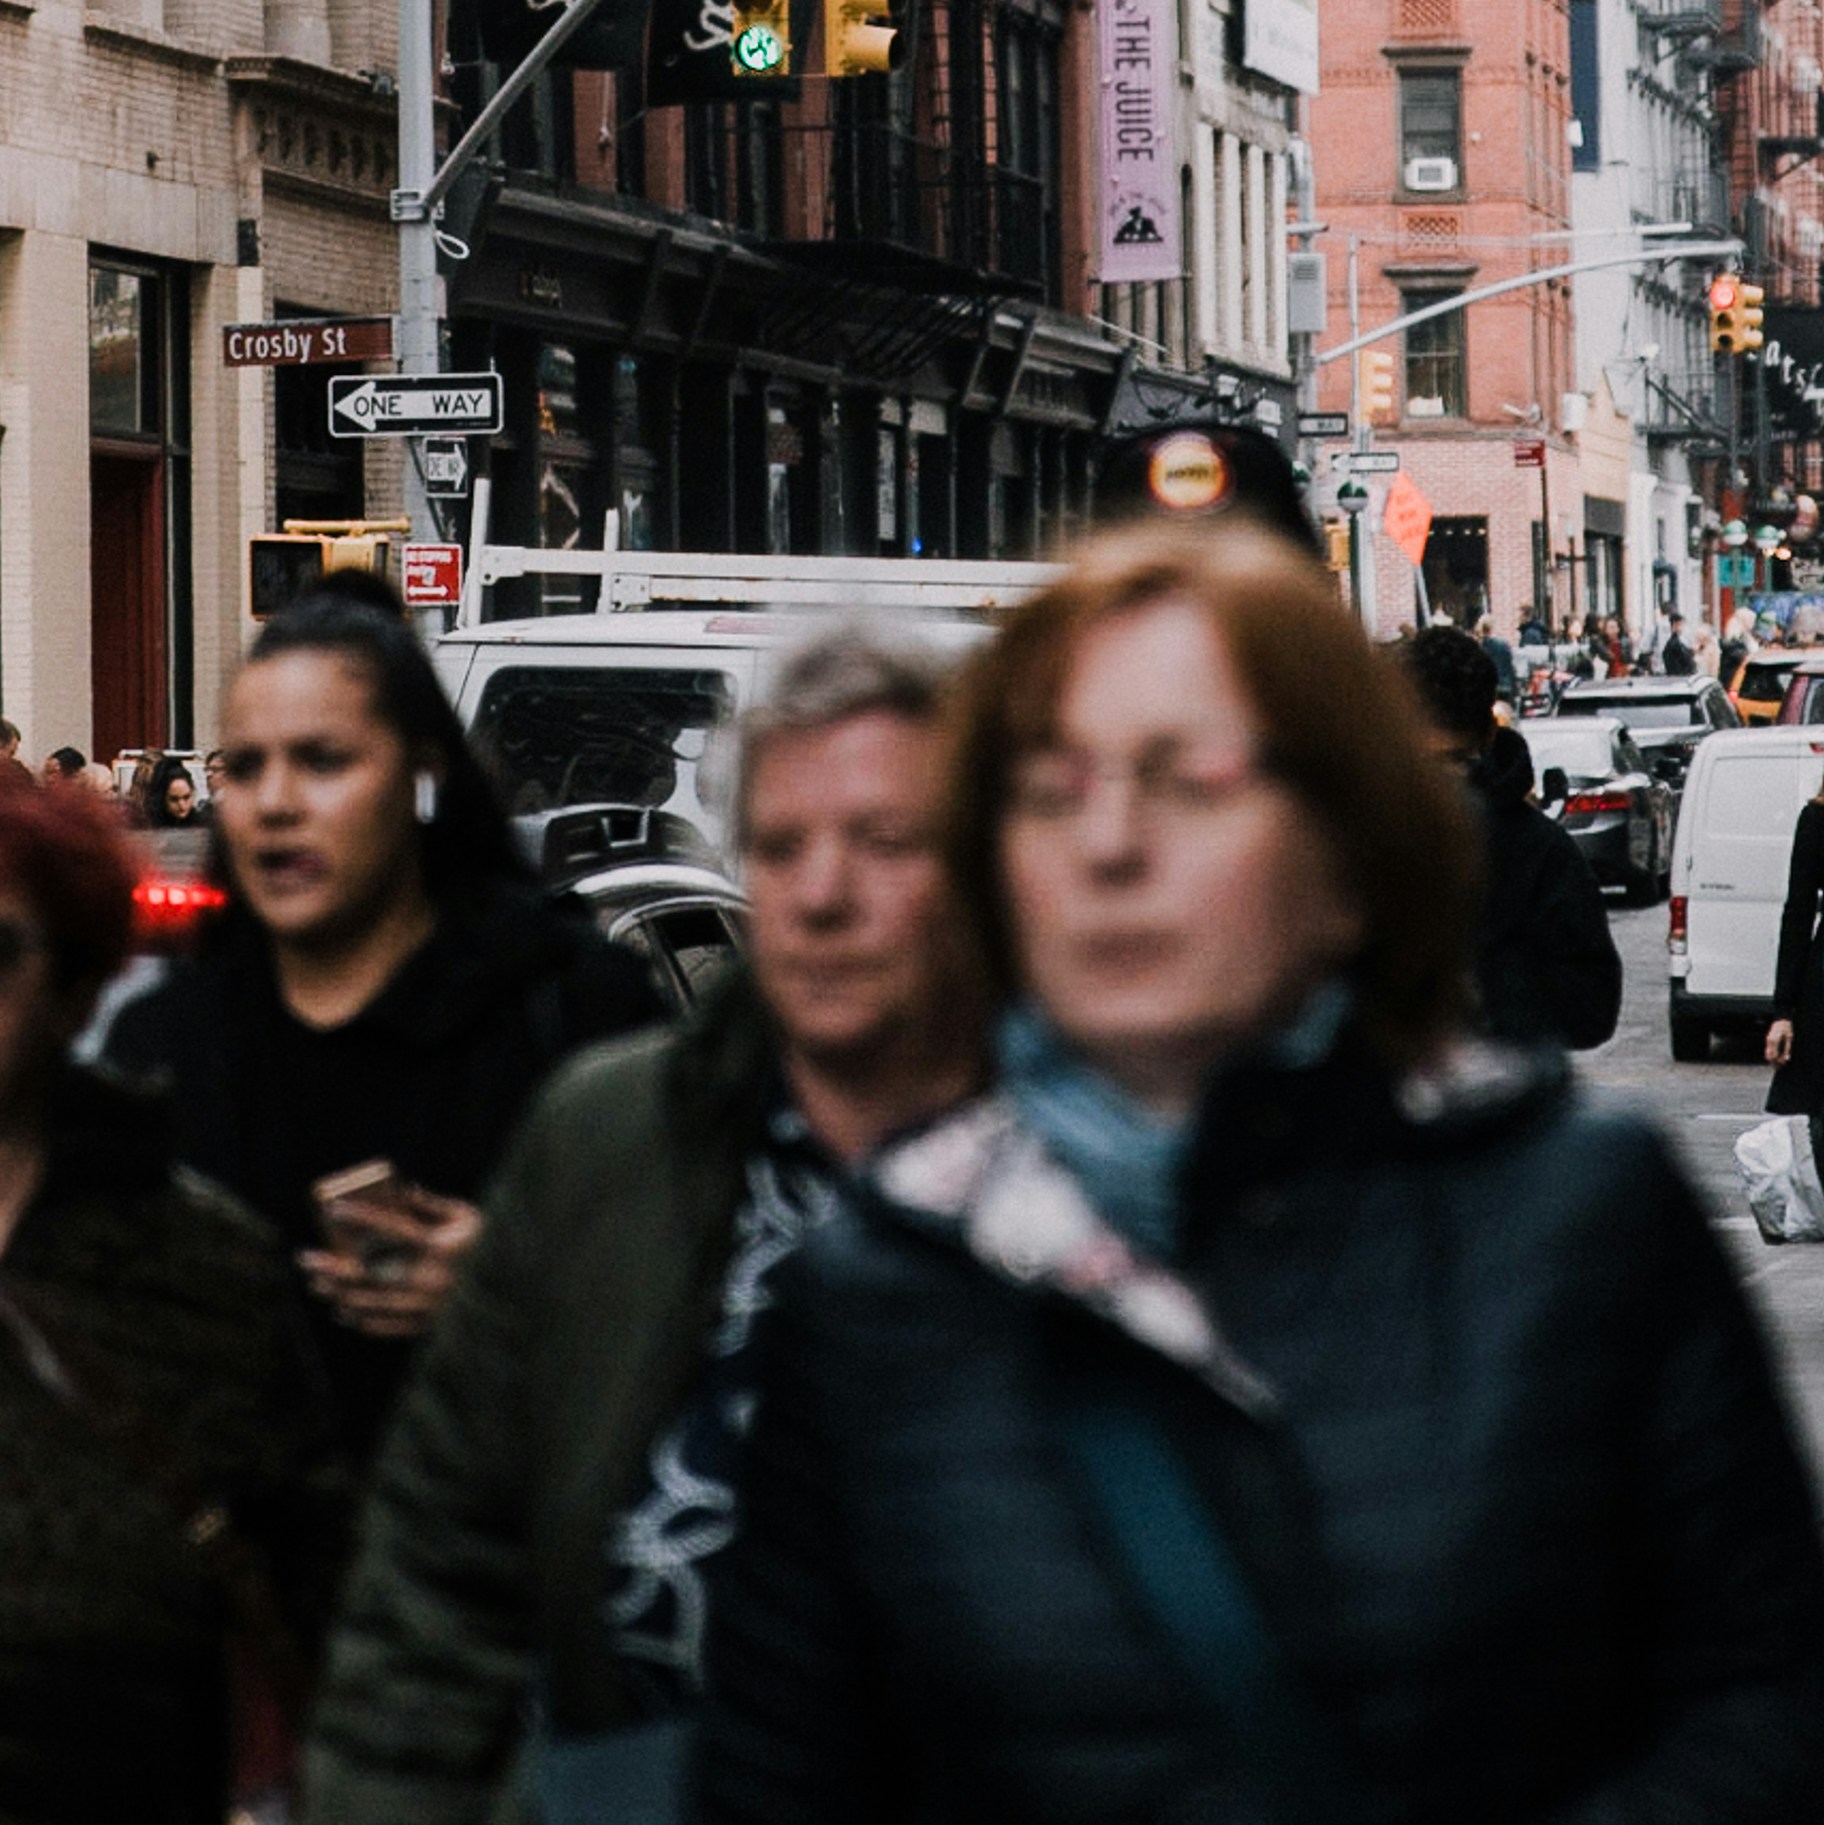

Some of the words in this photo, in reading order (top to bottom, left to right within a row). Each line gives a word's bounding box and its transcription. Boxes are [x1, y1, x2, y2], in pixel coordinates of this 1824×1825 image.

[1114, 14, 1153, 71] THE
[1115, 81, 1156, 162] JUICE
[228, 327, 312, 364] Crosby
[321, 327, 347, 356] St
[353, 394, 402, 417] ONE
[432, 393, 484, 415] WAY
